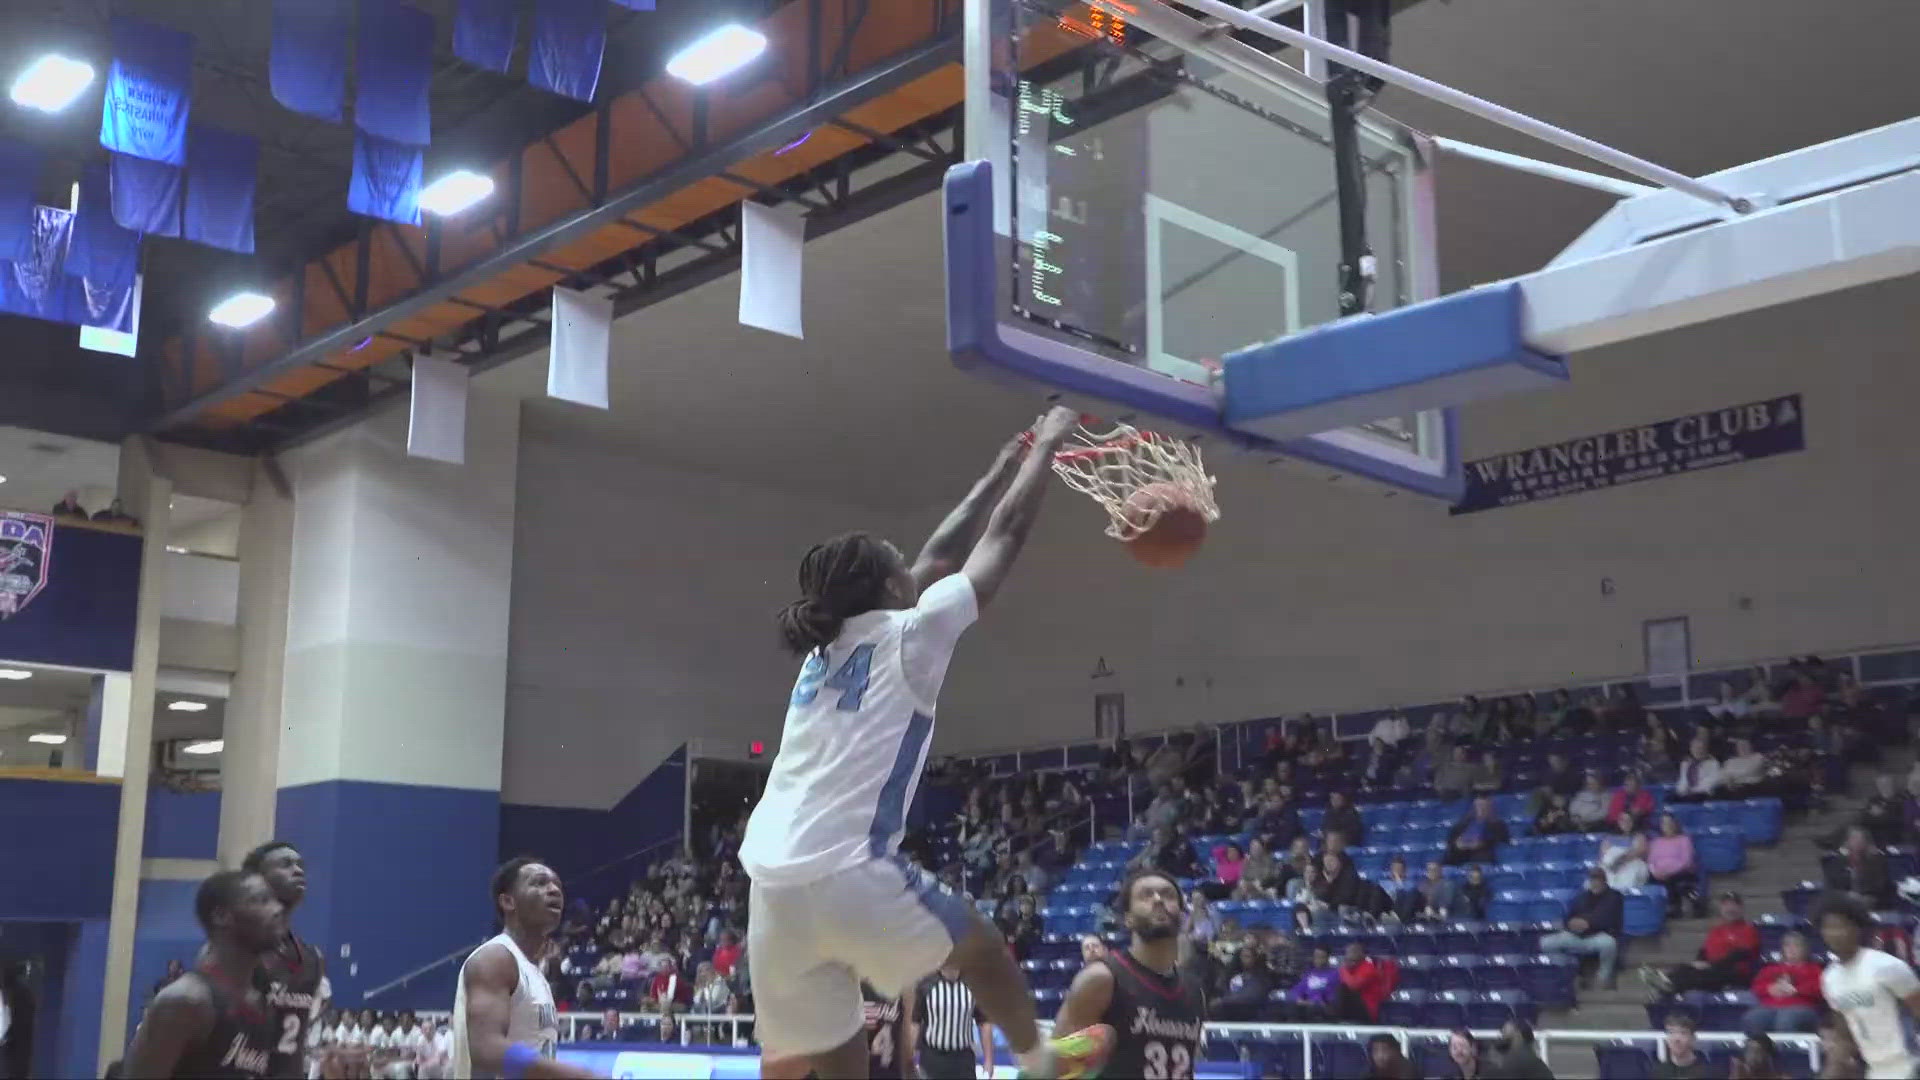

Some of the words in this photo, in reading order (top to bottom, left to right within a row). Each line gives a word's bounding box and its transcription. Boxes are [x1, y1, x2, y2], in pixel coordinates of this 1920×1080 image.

[1475, 427, 1659, 484] WRANGLER
[1673, 403, 1771, 444] CLUB
[790, 642, 877, 713] 24
[277, 1013, 302, 1055] 2
[870, 1023, 896, 1067] 4
[1143, 1041, 1191, 1080] 32
